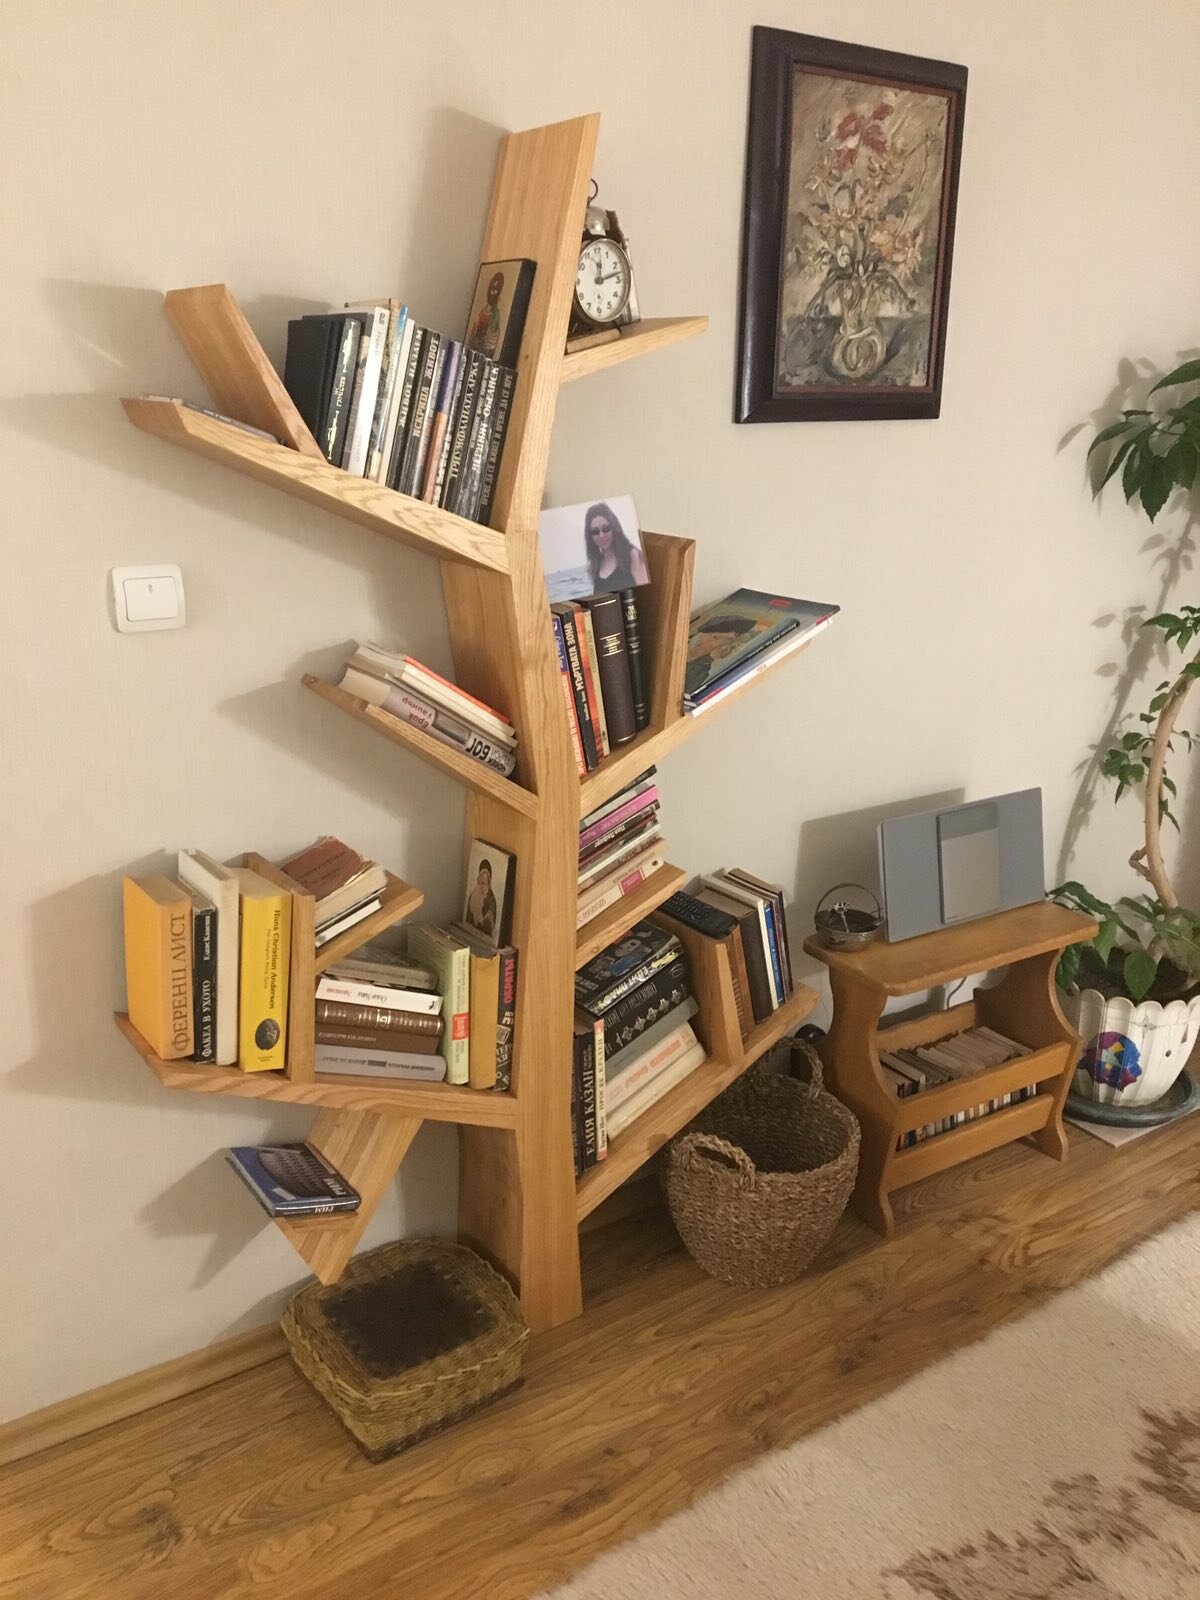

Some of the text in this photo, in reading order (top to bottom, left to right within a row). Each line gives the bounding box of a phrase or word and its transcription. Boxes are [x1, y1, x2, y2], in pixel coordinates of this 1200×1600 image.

[612, 261, 618, 269] 2
[615, 275, 621, 284] 3
[579, 292, 584, 300] 8
[606, 301, 612, 309] 5
[612, 290, 618, 298] 4
[586, 302, 592, 310] 7
[596, 305, 602, 314] 6
[412, 386, 429, 437] ИСКРИЦА
[423, 337, 439, 378] ЖИВОТ
[466, 361, 479, 392] АРКА
[483, 366, 500, 415] ОБЕЛИСК
[502, 388, 509, 398] СЕ
[398, 382, 412, 427] ЖИВОТ
[499, 396, 509, 408] ДА
[564, 622, 576, 645] ЗОНА
[568, 646, 584, 690] МЪРТВАТА
[465, 738, 490, 760] БОГ
[488, 757, 506, 772] ЧОВЕК
[272, 909, 280, 930] Hans
[270, 932, 278, 970] Christian
[170, 912, 190, 1050] ФЕРЕНЦ ЛИСТ
[201, 979, 210, 1012] УХОТО
[201, 1025, 211, 1057] ФАКЕЛ
[583, 1069, 593, 1114] КАЗАН
[585, 1117, 594, 1154] ЕЛИЯ
